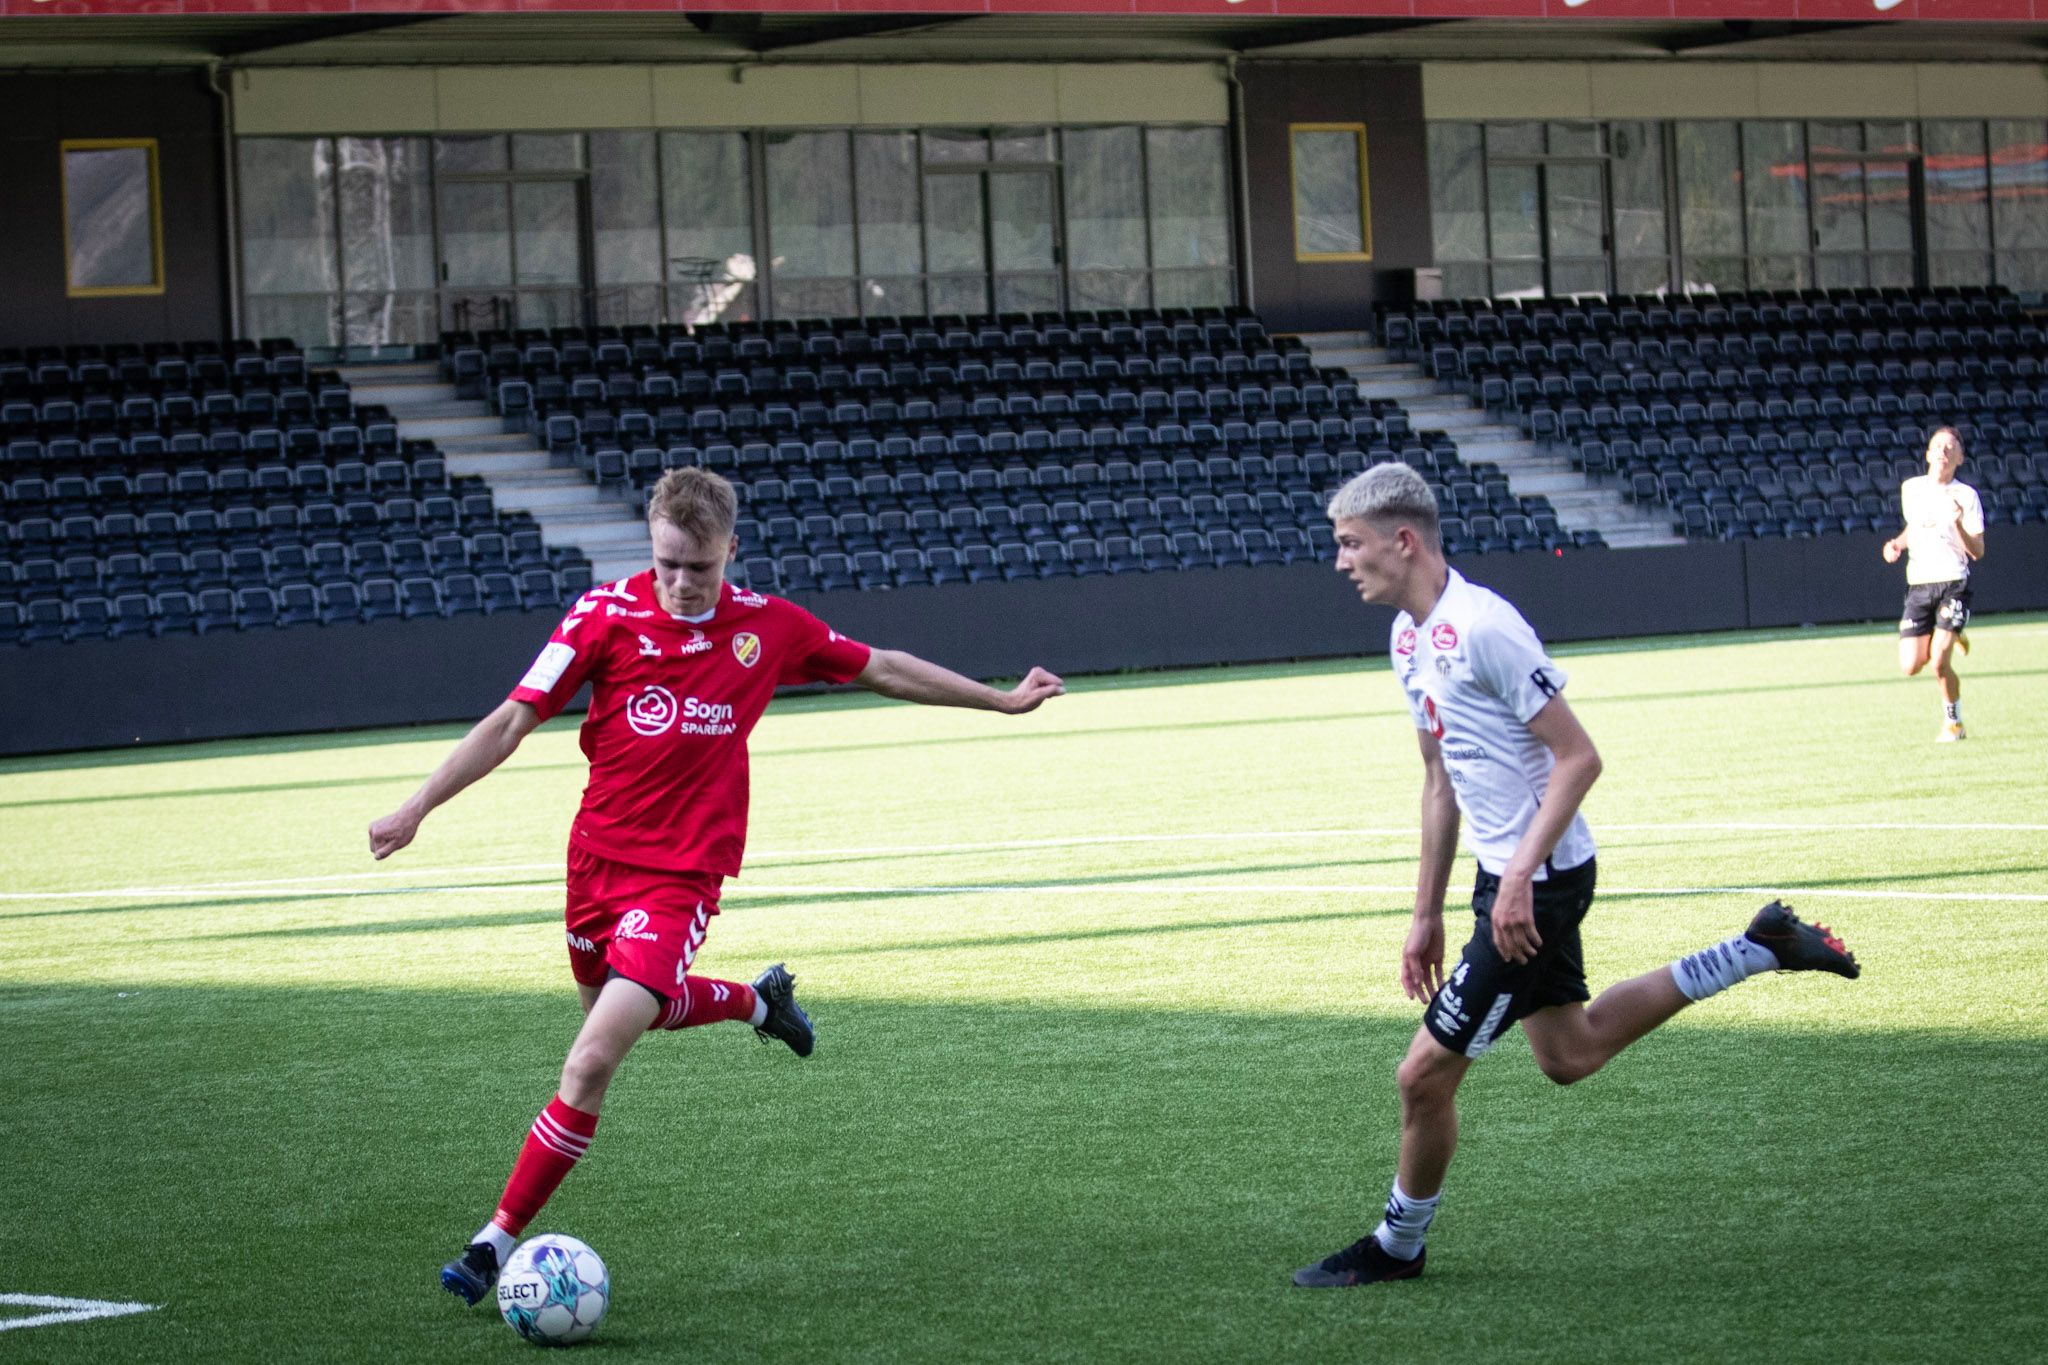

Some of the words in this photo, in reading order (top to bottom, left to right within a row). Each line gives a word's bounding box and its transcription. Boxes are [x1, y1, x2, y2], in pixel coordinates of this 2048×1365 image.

[681, 640, 713, 654] Hydro
[683, 697, 733, 724] Sogn
[499, 1283, 539, 1301] SELECT
